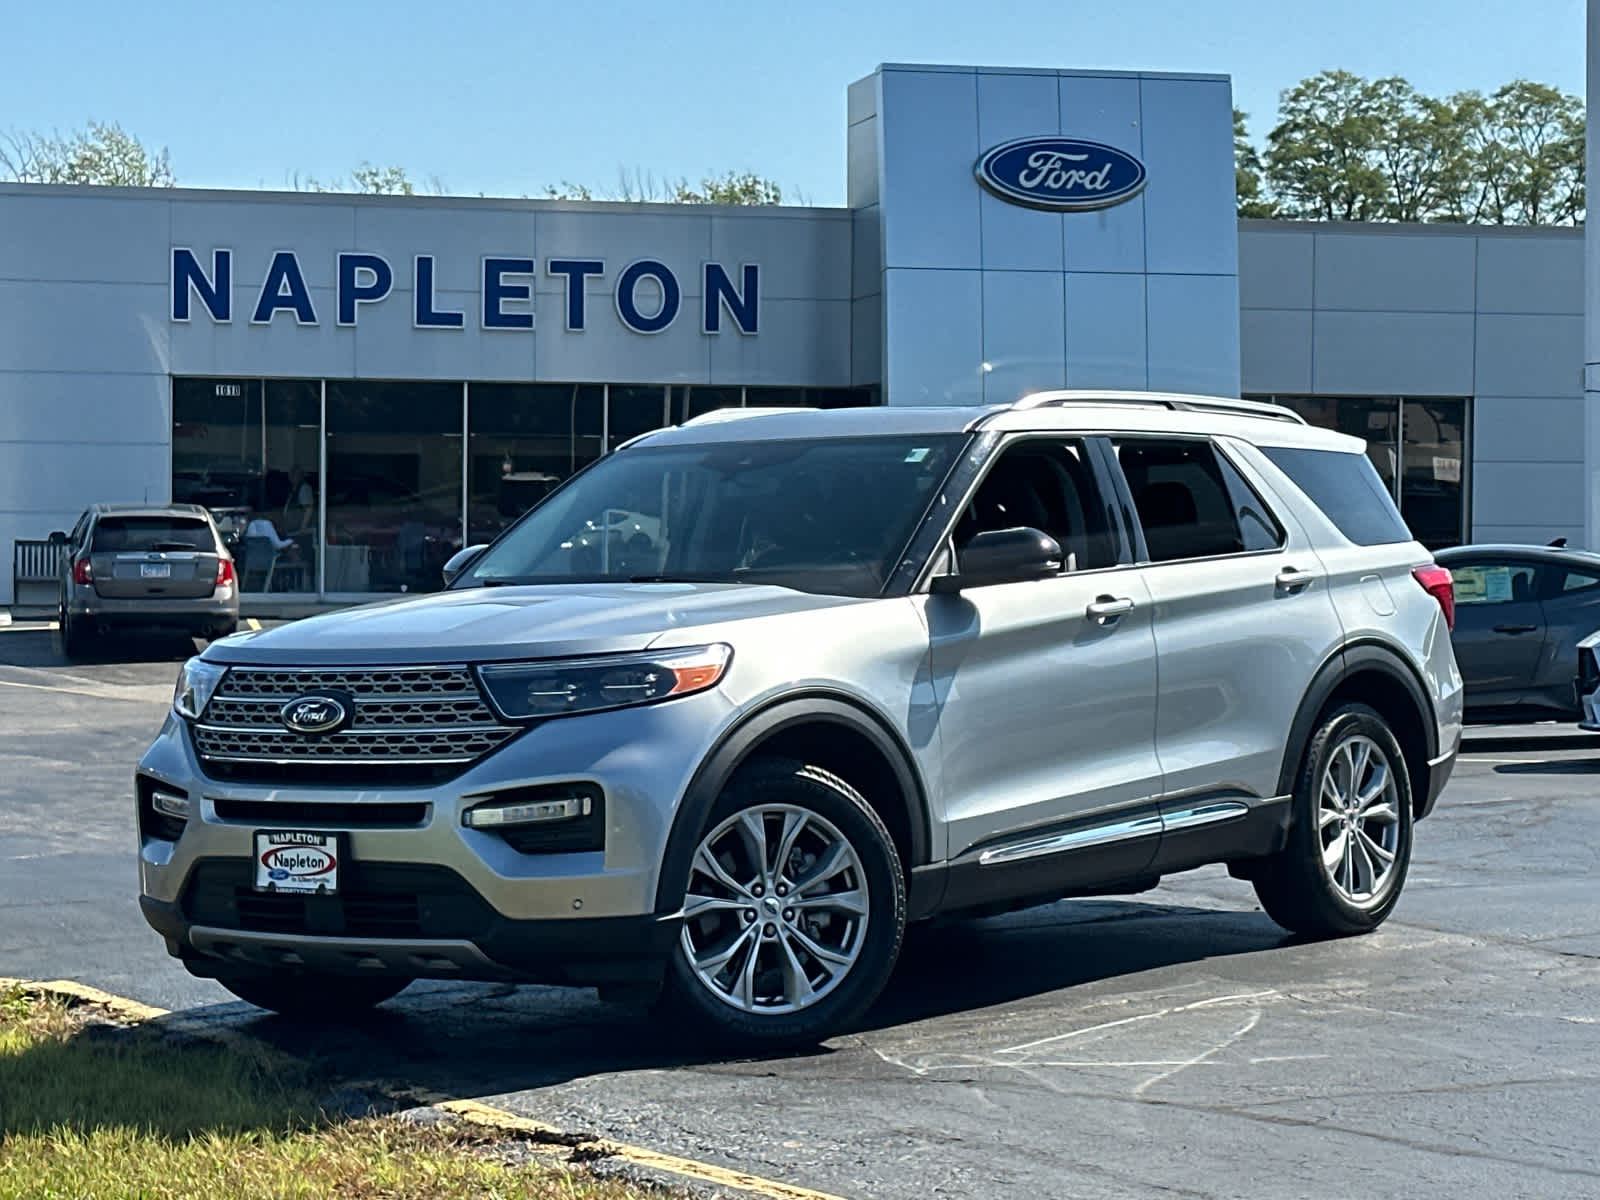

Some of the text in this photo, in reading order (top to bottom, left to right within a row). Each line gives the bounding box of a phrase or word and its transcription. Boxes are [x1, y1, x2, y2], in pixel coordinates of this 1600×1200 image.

[1018, 150, 1113, 190] Ford
[170, 247, 760, 336] NAPLETON
[292, 703, 328, 723] Ford
[272, 833, 321, 845] NAPLETON
[274, 853, 325, 870] Napleton
